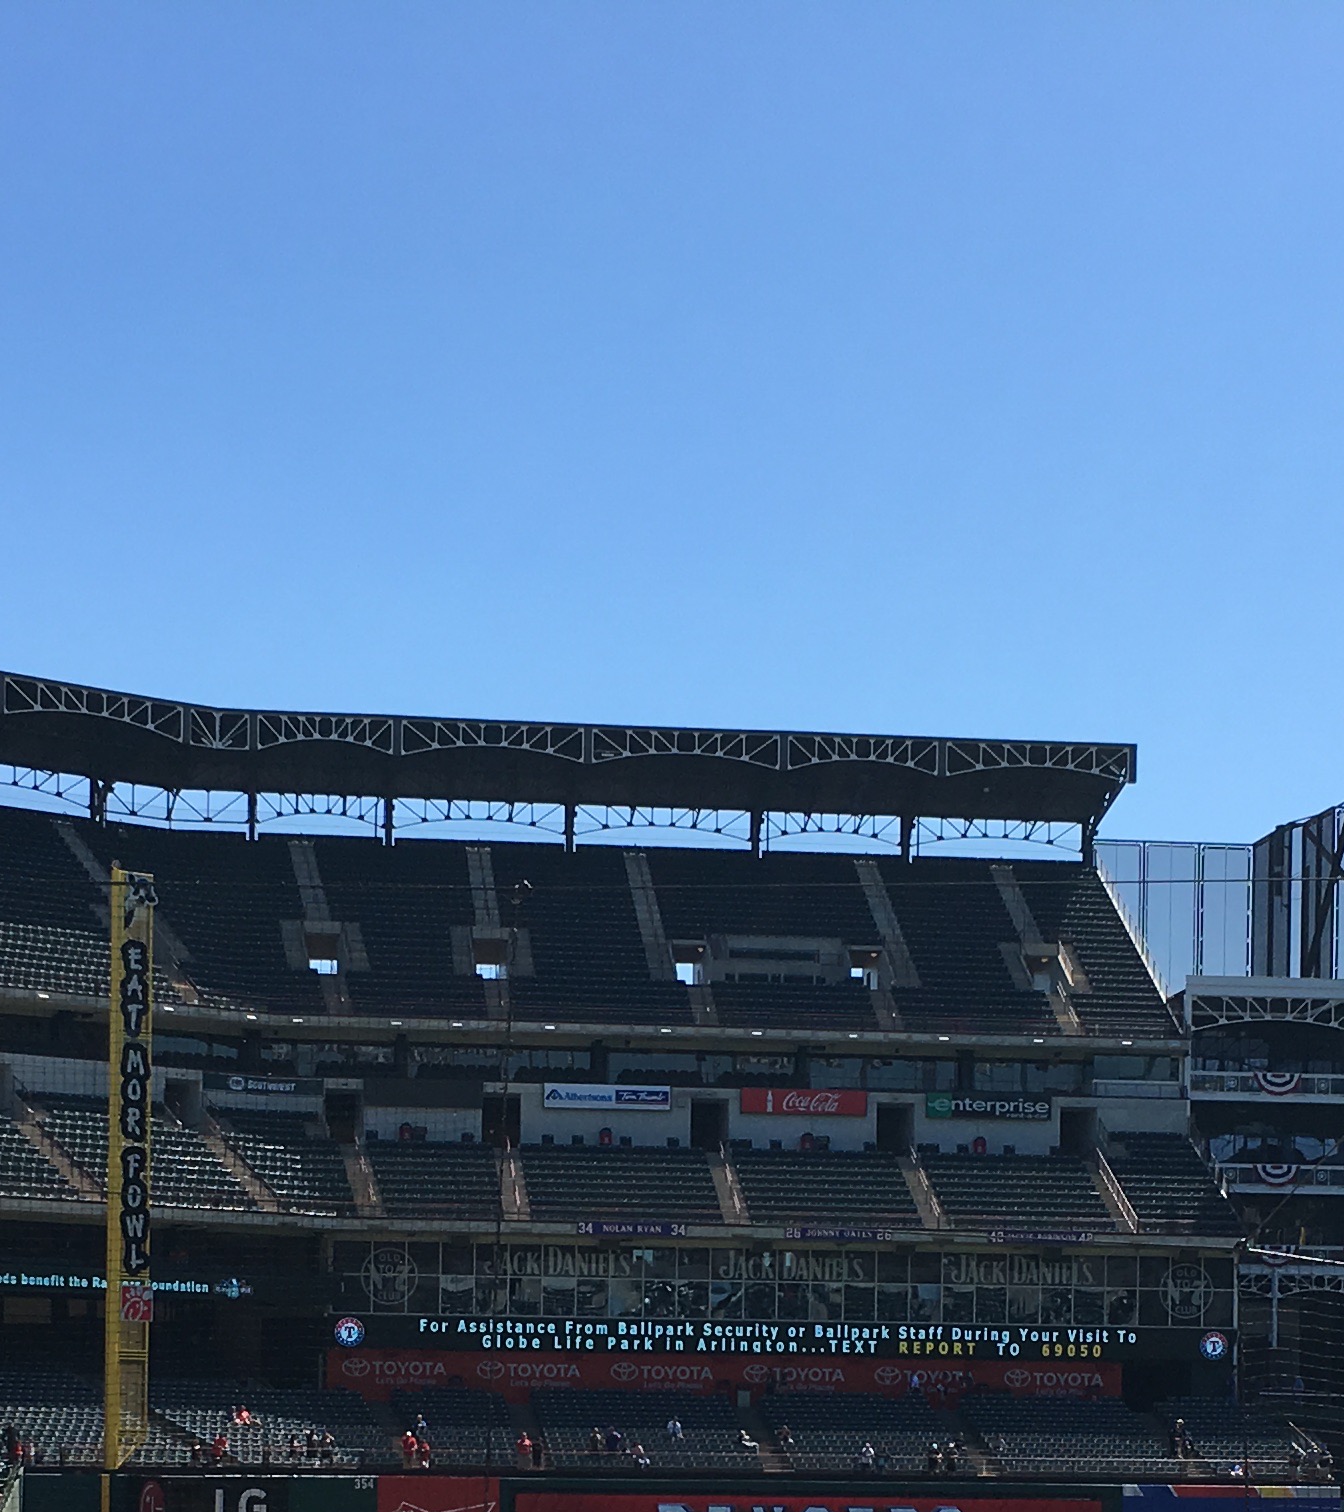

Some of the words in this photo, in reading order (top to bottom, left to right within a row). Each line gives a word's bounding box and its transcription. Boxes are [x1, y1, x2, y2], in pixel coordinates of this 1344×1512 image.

[127, 947, 143, 1031] EAT
[127, 1048, 145, 1136] MOR
[932, 1098, 1050, 1117] enterprise
[126, 1153, 145, 1270] FOWL
[578, 1222, 593, 1234] 34
[602, 1224, 633, 1234] NOLAN
[637, 1225, 662, 1234] RYAN
[670, 1224, 686, 1236] 34
[876, 1229, 892, 1241] 26
[379, 1253, 401, 1262] OLD
[719, 1249, 775, 1280] JACK
[21, 1272, 64, 1287] benefit
[68, 1274, 89, 1287] the
[377, 1292, 402, 1301] CLUB
[419, 1319, 448, 1333] For
[457, 1319, 556, 1334] Assistance
[565, 1321, 608, 1335] From
[618, 1322, 694, 1340] Ballpark
[703, 1323, 778, 1340] Security
[787, 1326, 806, 1338] or
[815, 1324, 890, 1341] Ballpark
[898, 1325, 943, 1340] Staff
[951, 1327, 1010, 1344] During
[1019, 1328, 1059, 1342] Your
[1068, 1329, 1109, 1343] Visit
[1118, 1329, 1137, 1344] To
[482, 1335, 541, 1349] Globe
[554, 1335, 595, 1350] Life
[607, 1336, 653, 1350] Park
[666, 1337, 684, 1351] in
[899, 1340, 977, 1355] REPORT
[997, 1343, 1020, 1356] TO
[1042, 1344, 1102, 1357] 69050
[372, 1361, 447, 1375] TOYOTA
[507, 1363, 581, 1378] TOYOTA
[640, 1365, 713, 1380] TOYOTA
[1033, 1373, 1104, 1387] TOYOTA
[354, 1478, 375, 1490] 354
